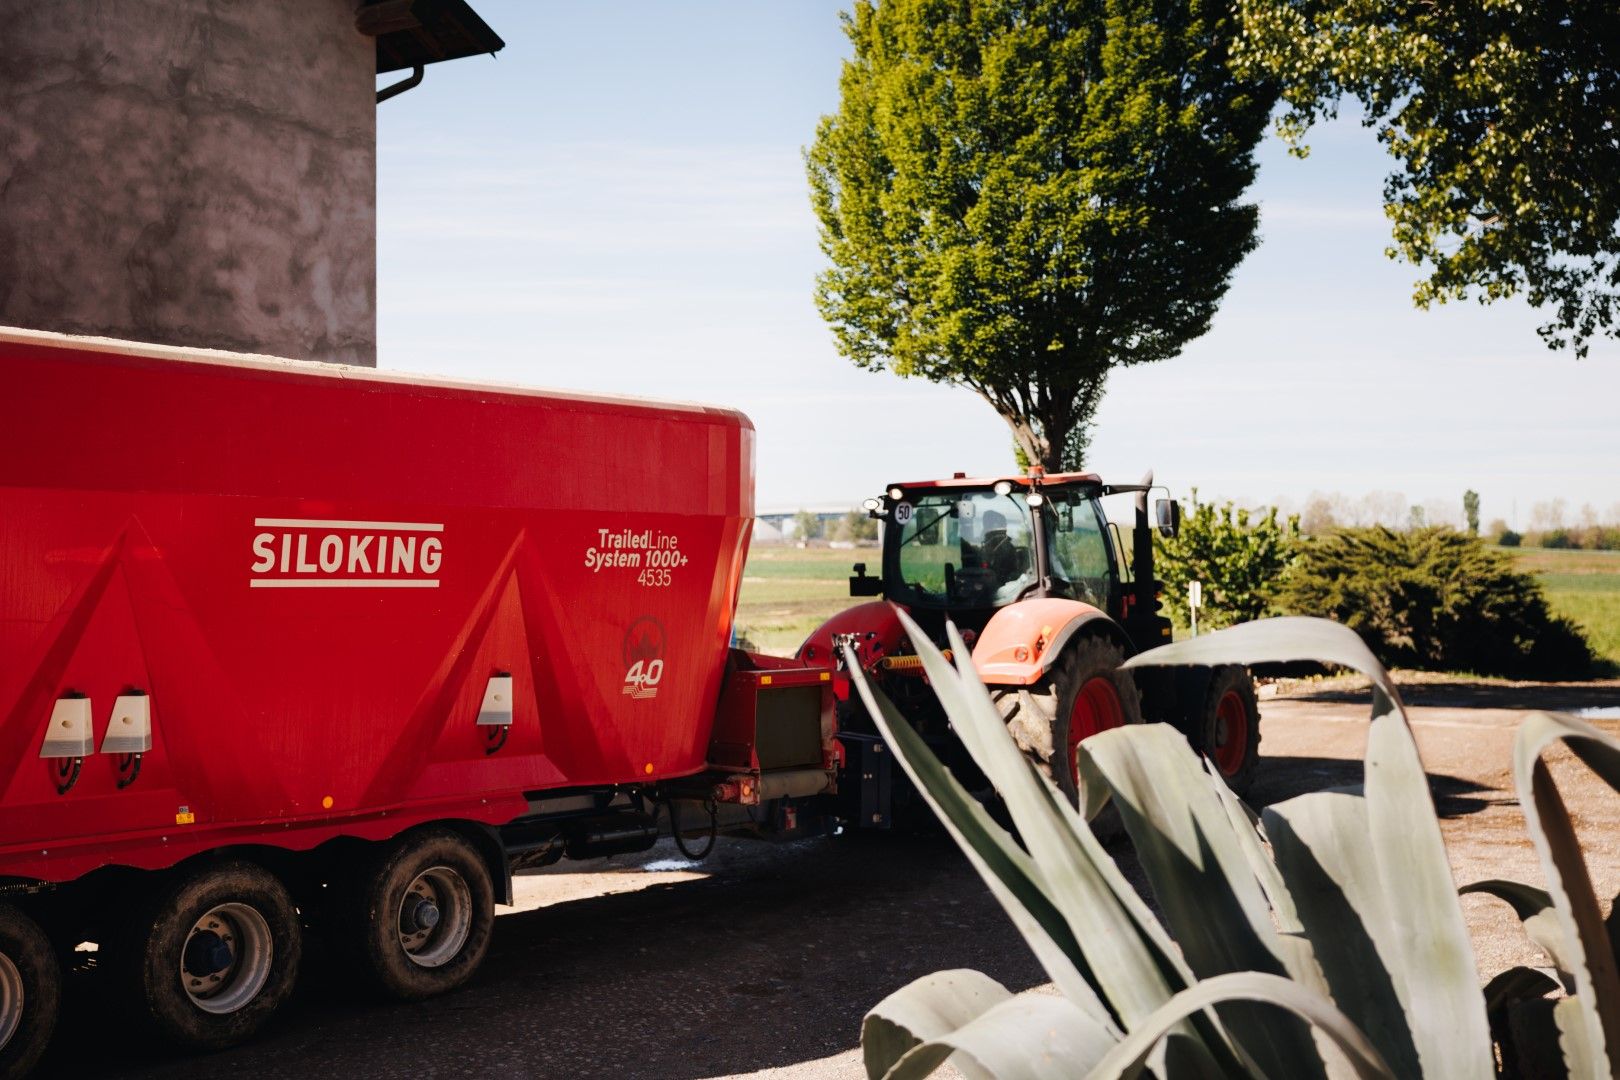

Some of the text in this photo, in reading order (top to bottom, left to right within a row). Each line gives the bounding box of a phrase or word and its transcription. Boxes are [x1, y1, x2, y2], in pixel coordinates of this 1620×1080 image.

[898, 505, 910, 520] 50
[598, 529, 678, 549] TrailedLine
[251, 533, 443, 574] SILOKING
[584, 547, 689, 573] System 1000+
[637, 569, 672, 587] 4535
